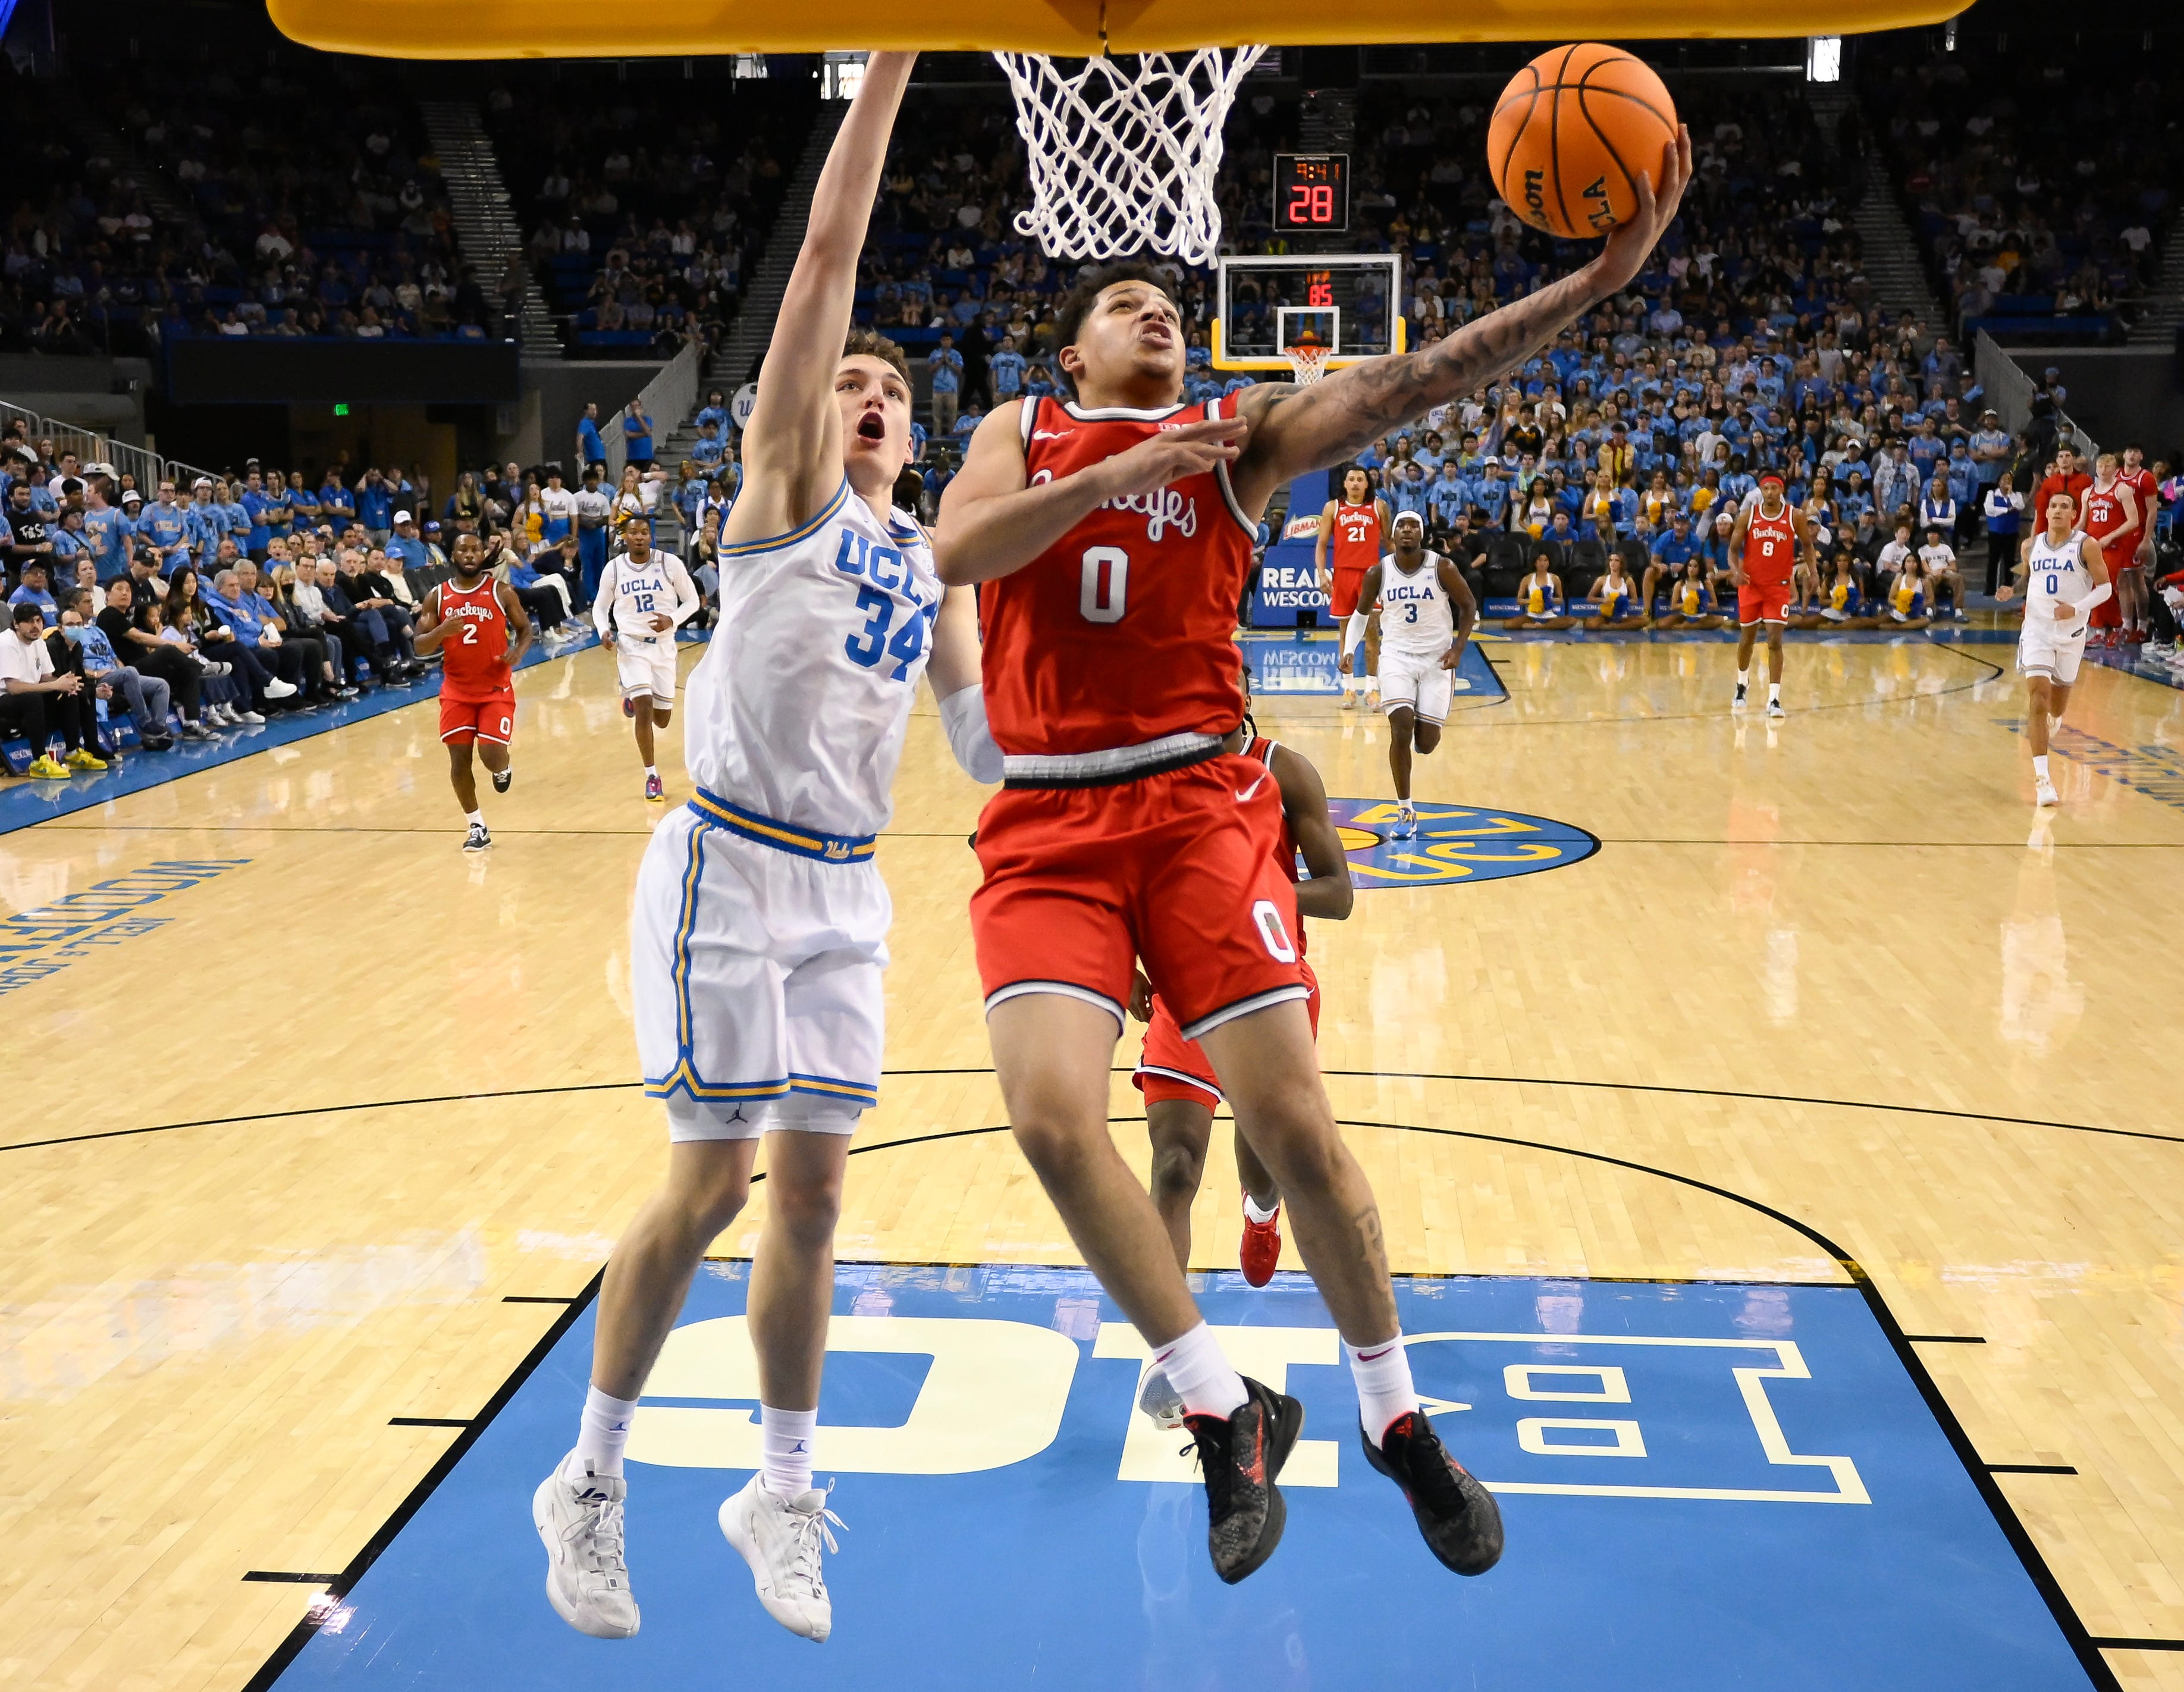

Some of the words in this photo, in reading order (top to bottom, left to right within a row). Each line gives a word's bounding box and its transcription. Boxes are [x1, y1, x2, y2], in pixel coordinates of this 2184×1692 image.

[1297, 163, 1339, 180] 9:41
[1289, 186, 1332, 223] 28
[1582, 176, 1617, 230] CLA
[1310, 284, 1332, 306] 85
[1339, 511, 1373, 527] Buckeyes
[2092, 509, 2108, 522] 20
[1347, 527, 1366, 543] 21
[1752, 526, 1787, 542] Buckeyes
[1762, 541, 1774, 556] 8
[2032, 559, 2075, 572] UCLA
[621, 579, 664, 595] UCLA
[1079, 545, 1129, 624] 0
[1263, 568, 1334, 588] READ
[2046, 574, 2059, 594] 0
[633, 593, 655, 613] 12
[1387, 585, 1435, 602] UCLA
[1404, 603, 1418, 623] 3
[463, 623, 478, 645] 2
[844, 583, 928, 682] 34
